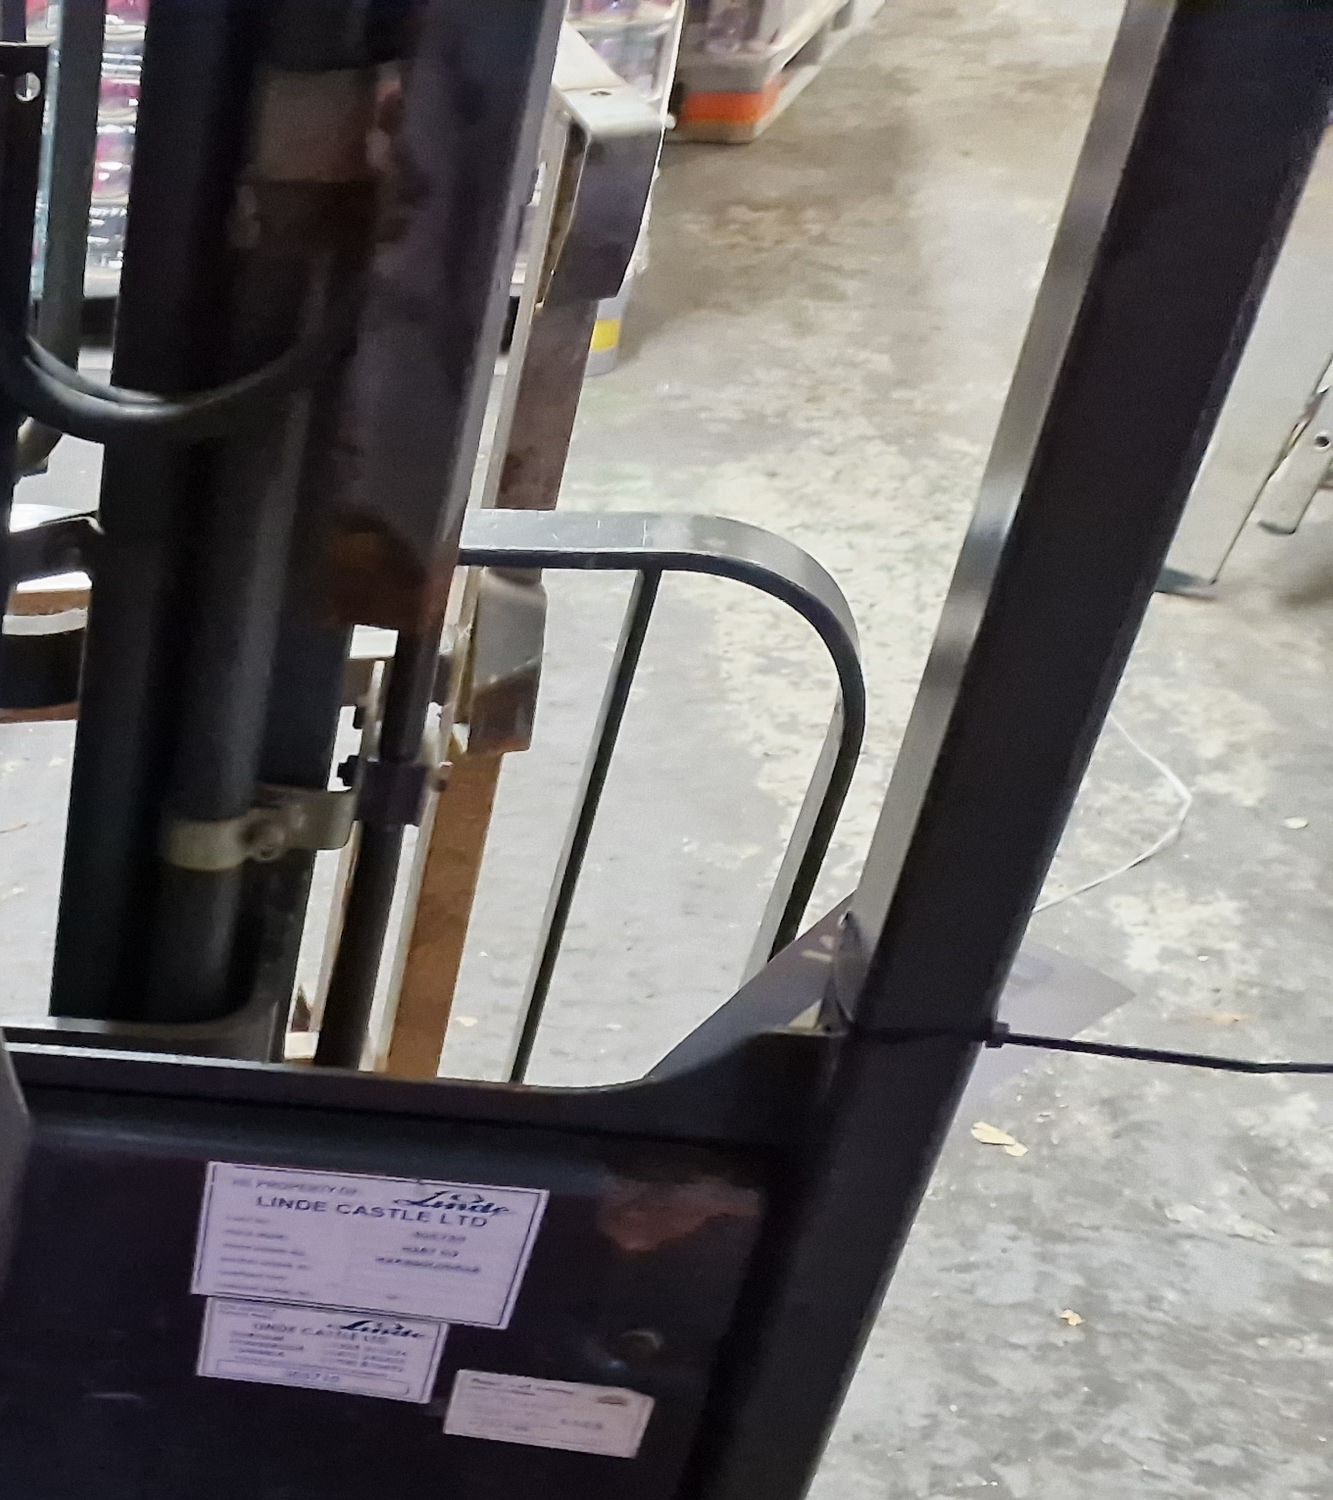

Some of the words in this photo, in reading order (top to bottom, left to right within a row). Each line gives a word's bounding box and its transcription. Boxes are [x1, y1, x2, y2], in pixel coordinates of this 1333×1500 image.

[256, 1195, 327, 1213] LINDE
[335, 1203, 431, 1223] CASTLE
[439, 1213, 488, 1228] LTD
[393, 1190, 510, 1217] Linde
